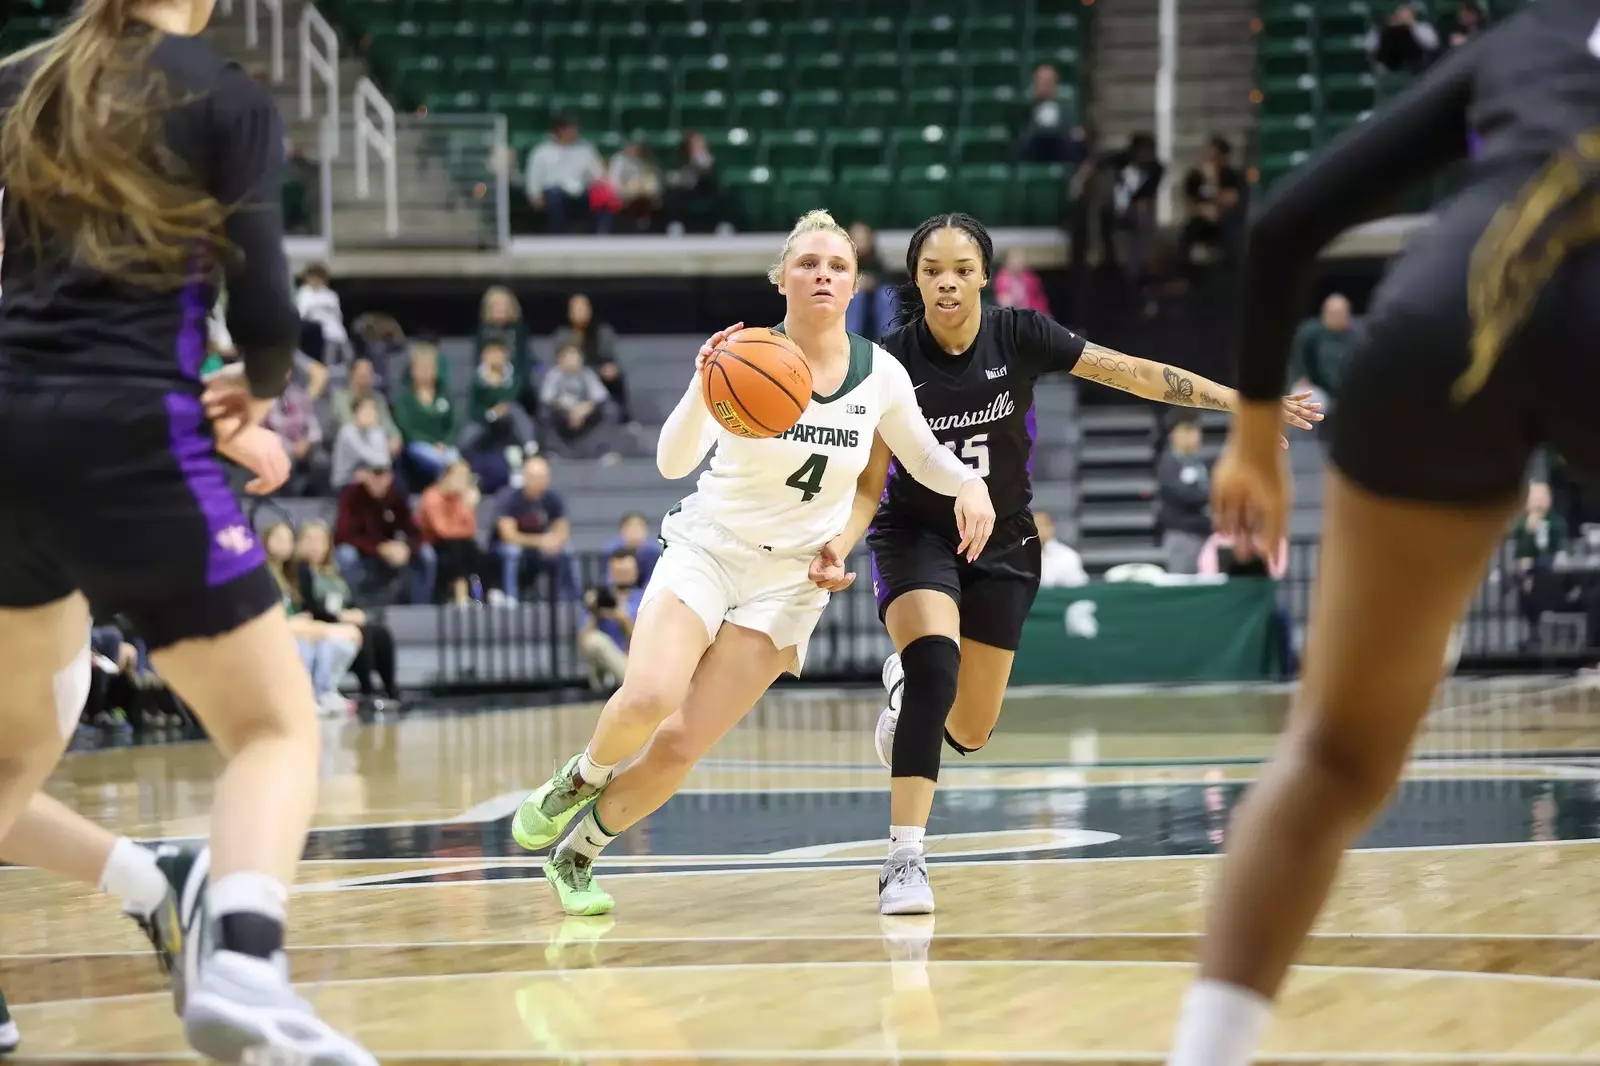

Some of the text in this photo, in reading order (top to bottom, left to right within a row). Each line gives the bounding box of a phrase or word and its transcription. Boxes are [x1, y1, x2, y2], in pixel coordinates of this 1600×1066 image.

[985, 364, 1008, 380] VALLEY
[918, 390, 1015, 431] vansville
[774, 423, 859, 448] PARTANS
[944, 433, 990, 478] 5
[785, 453, 829, 502] 4
